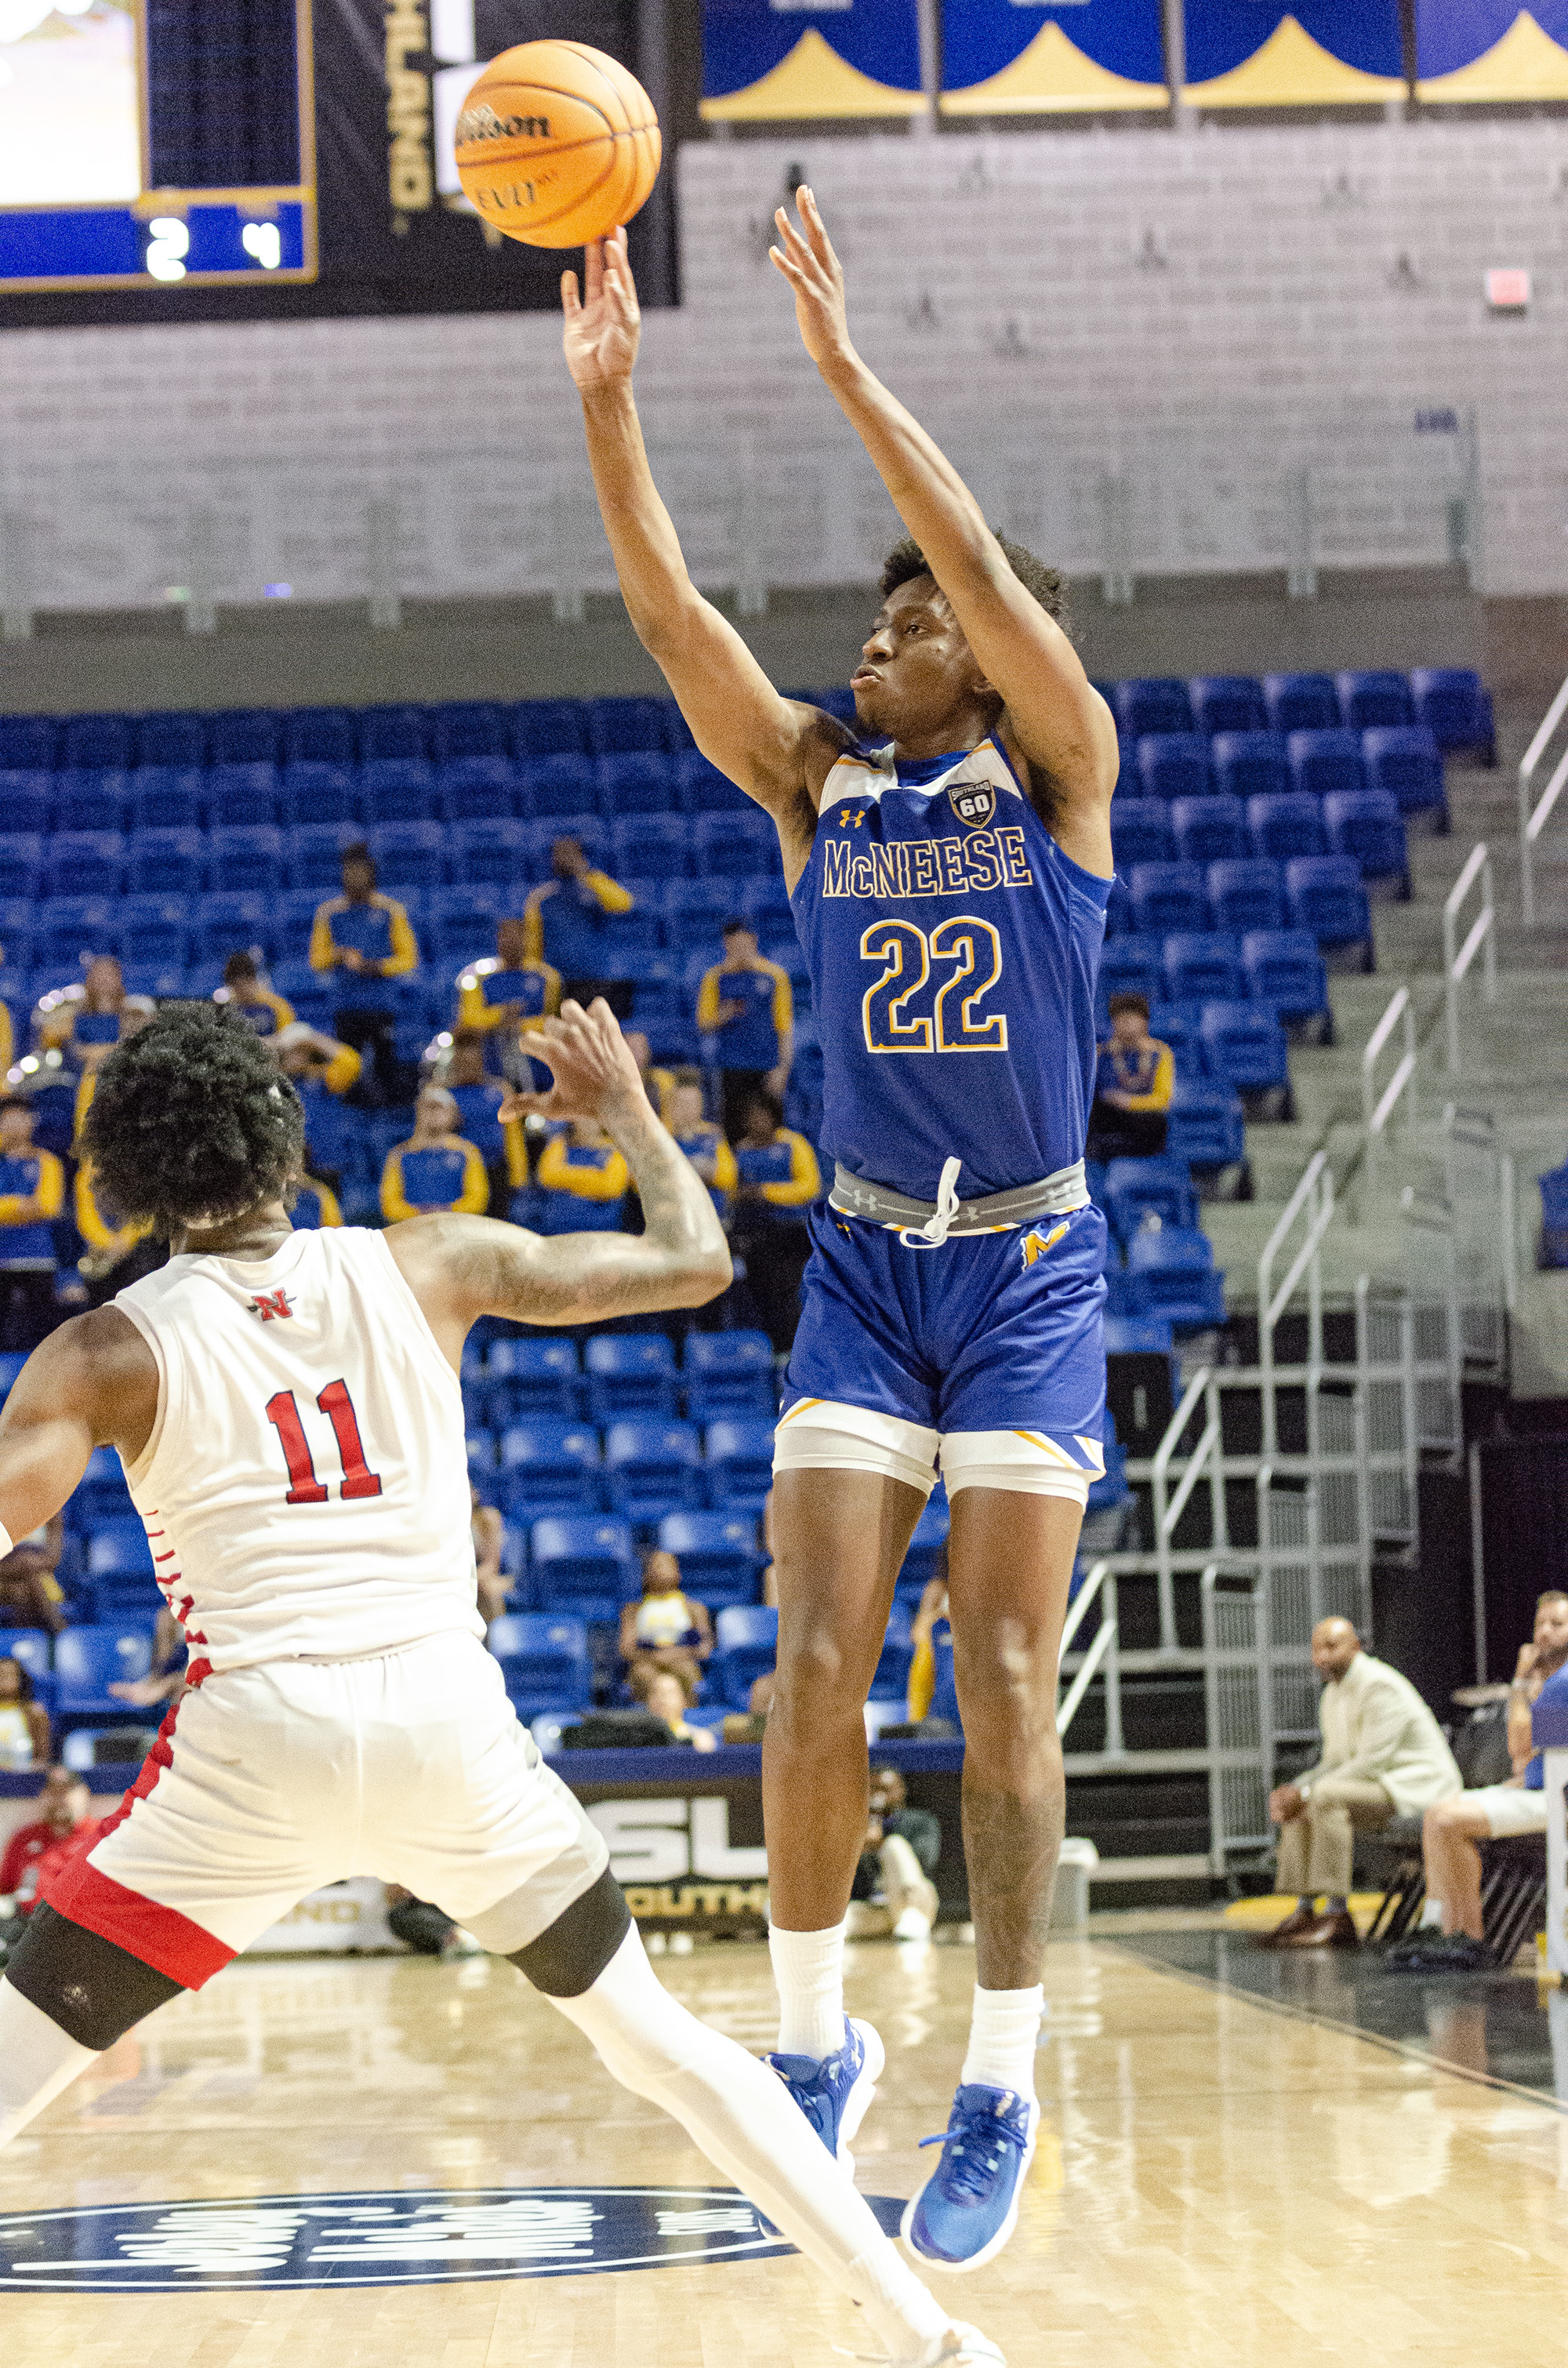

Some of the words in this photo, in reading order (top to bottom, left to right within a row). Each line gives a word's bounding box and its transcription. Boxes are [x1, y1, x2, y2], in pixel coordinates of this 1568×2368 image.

[147, 217, 189, 281] 2
[242, 223, 281, 269] 4
[960, 794, 990, 817] 60
[860, 915, 1008, 1053] 22
[252, 1287, 294, 1321] N
[265, 1378, 383, 1504] 11
[278, 1901, 362, 1923] ND
